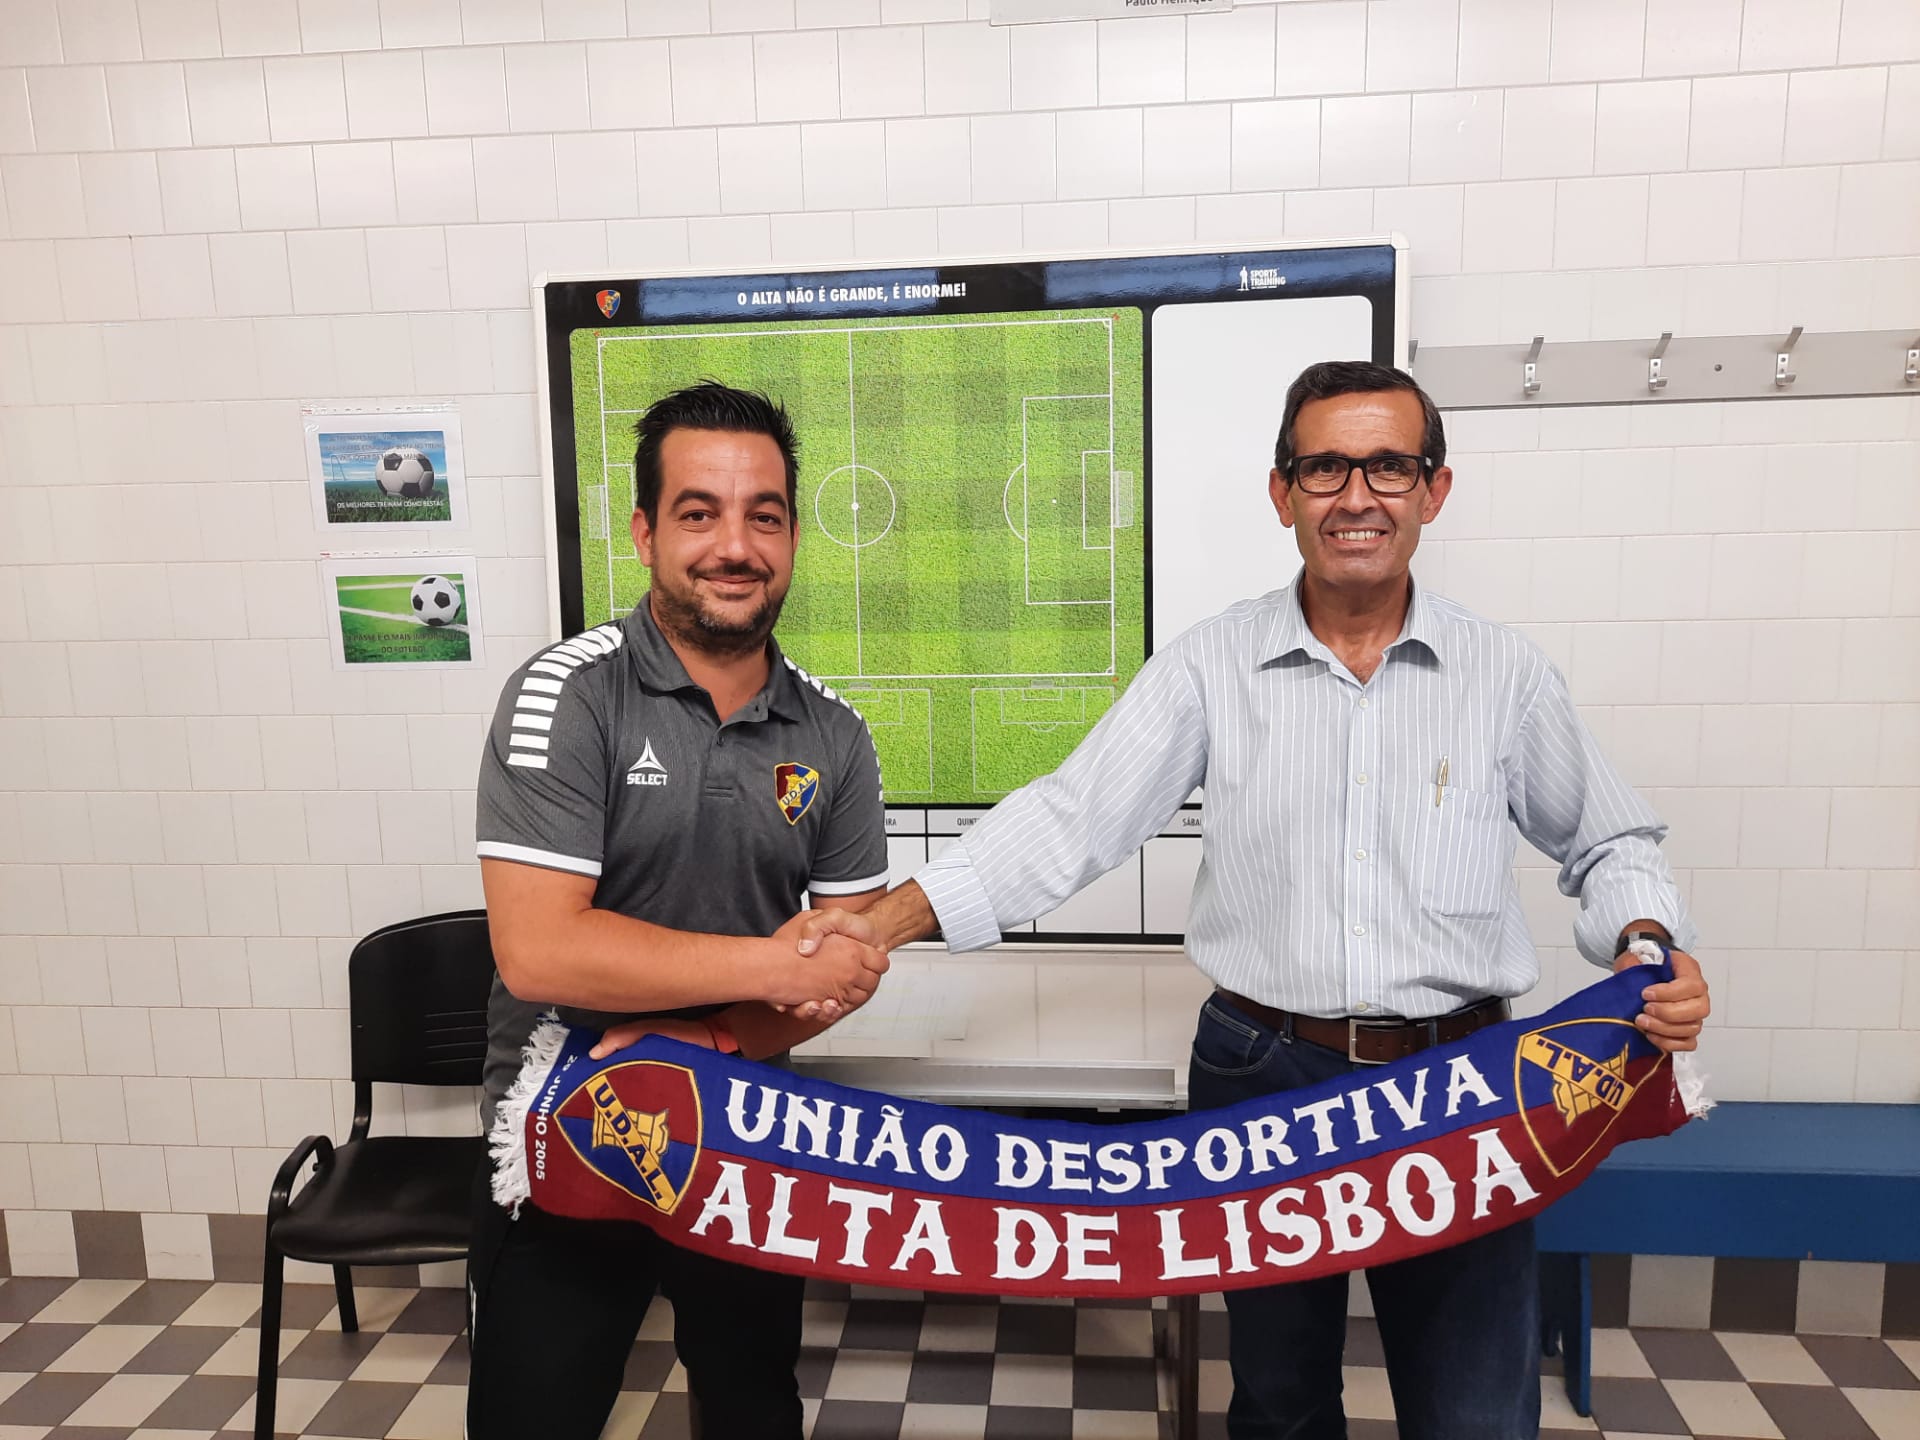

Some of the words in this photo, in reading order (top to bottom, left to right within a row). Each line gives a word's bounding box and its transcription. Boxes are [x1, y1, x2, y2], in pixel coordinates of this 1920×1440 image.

[1250, 269, 1277, 278] SPORTS
[1250, 276, 1286, 286] TRAINING
[737, 292, 746, 305] O
[752, 290, 782, 305] ALTA
[786, 286, 814, 303] NÃO
[818, 285, 826, 302] É
[830, 286, 888, 303] GRANDE,
[893, 282, 900, 300] É
[904, 282, 967, 299] ENORME!
[346, 501, 376, 509] MELHORES
[626, 773, 668, 786] SELECT
[1182, 816, 1202, 827] SÁBA
[535, 1074, 561, 1135] JUNHO
[725, 1077, 969, 1182] UNIÃO
[995, 1054, 1502, 1194] DESPORTIVA
[594, 1083, 663, 1200] U.D.A.L.
[535, 1139, 546, 1181] 2005
[689, 1160, 962, 1276] ALTA
[989, 1206, 1121, 1283] DE
[1153, 1128, 1541, 1281] LISBOA
